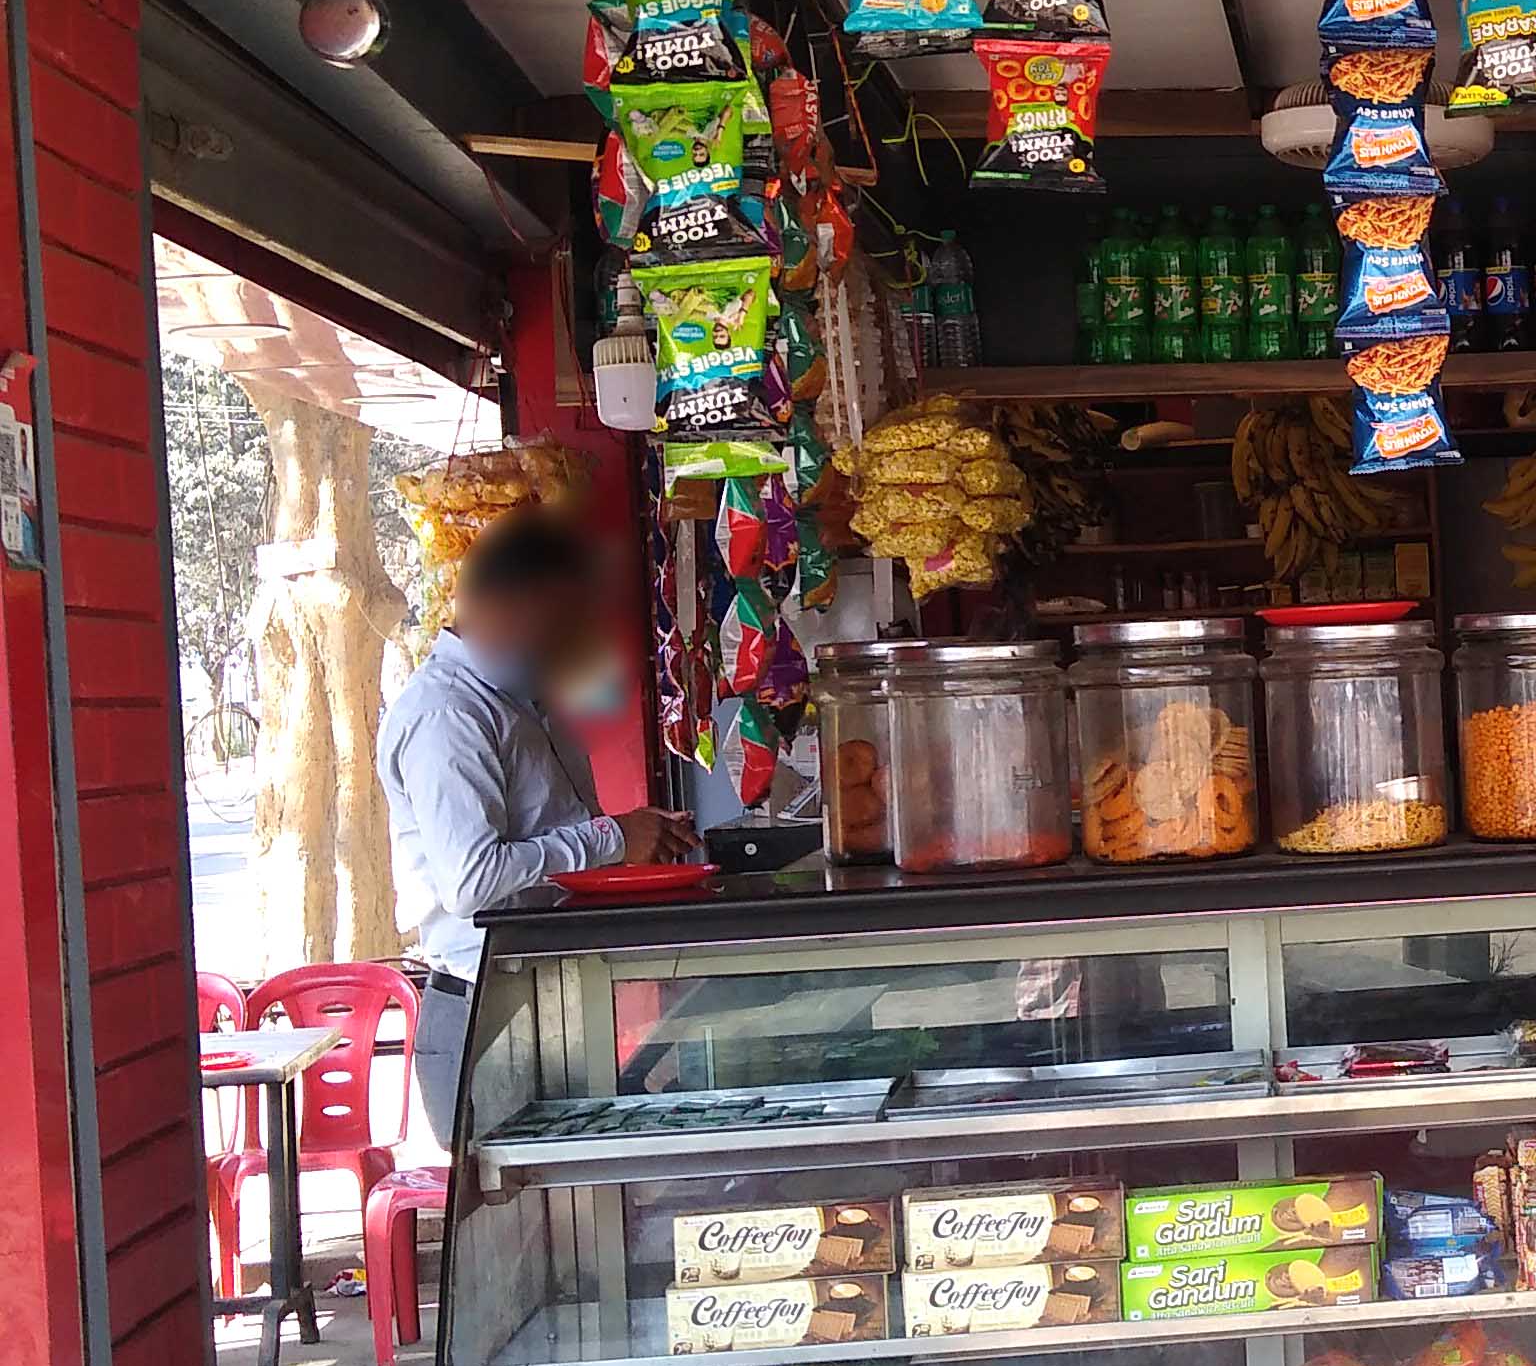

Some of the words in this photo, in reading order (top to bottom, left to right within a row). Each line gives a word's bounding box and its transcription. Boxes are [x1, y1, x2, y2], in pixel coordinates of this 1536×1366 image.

[636, 32, 716, 60] YUMM!
[655, 51, 704, 71] TOO
[1493, 63, 1534, 80] TOO
[1356, 107, 1379, 120] Sev
[1380, 107, 1416, 120] Khara
[1011, 133, 1076, 153] YUMM!
[1026, 147, 1065, 163] TOO
[671, 163, 736, 191] VEGGIE
[651, 205, 729, 237] YUMM!
[672, 223, 719, 244] TOO
[692, 346, 758, 373] VEGGIE
[669, 386, 749, 420] YUMM!
[689, 407, 738, 426] TOO
[1175, 1194, 1234, 1224] Sari
[1155, 1214, 1263, 1246] Gandum
[1168, 1259, 1227, 1289] Sari
[1148, 1279, 1256, 1311] Gandum
